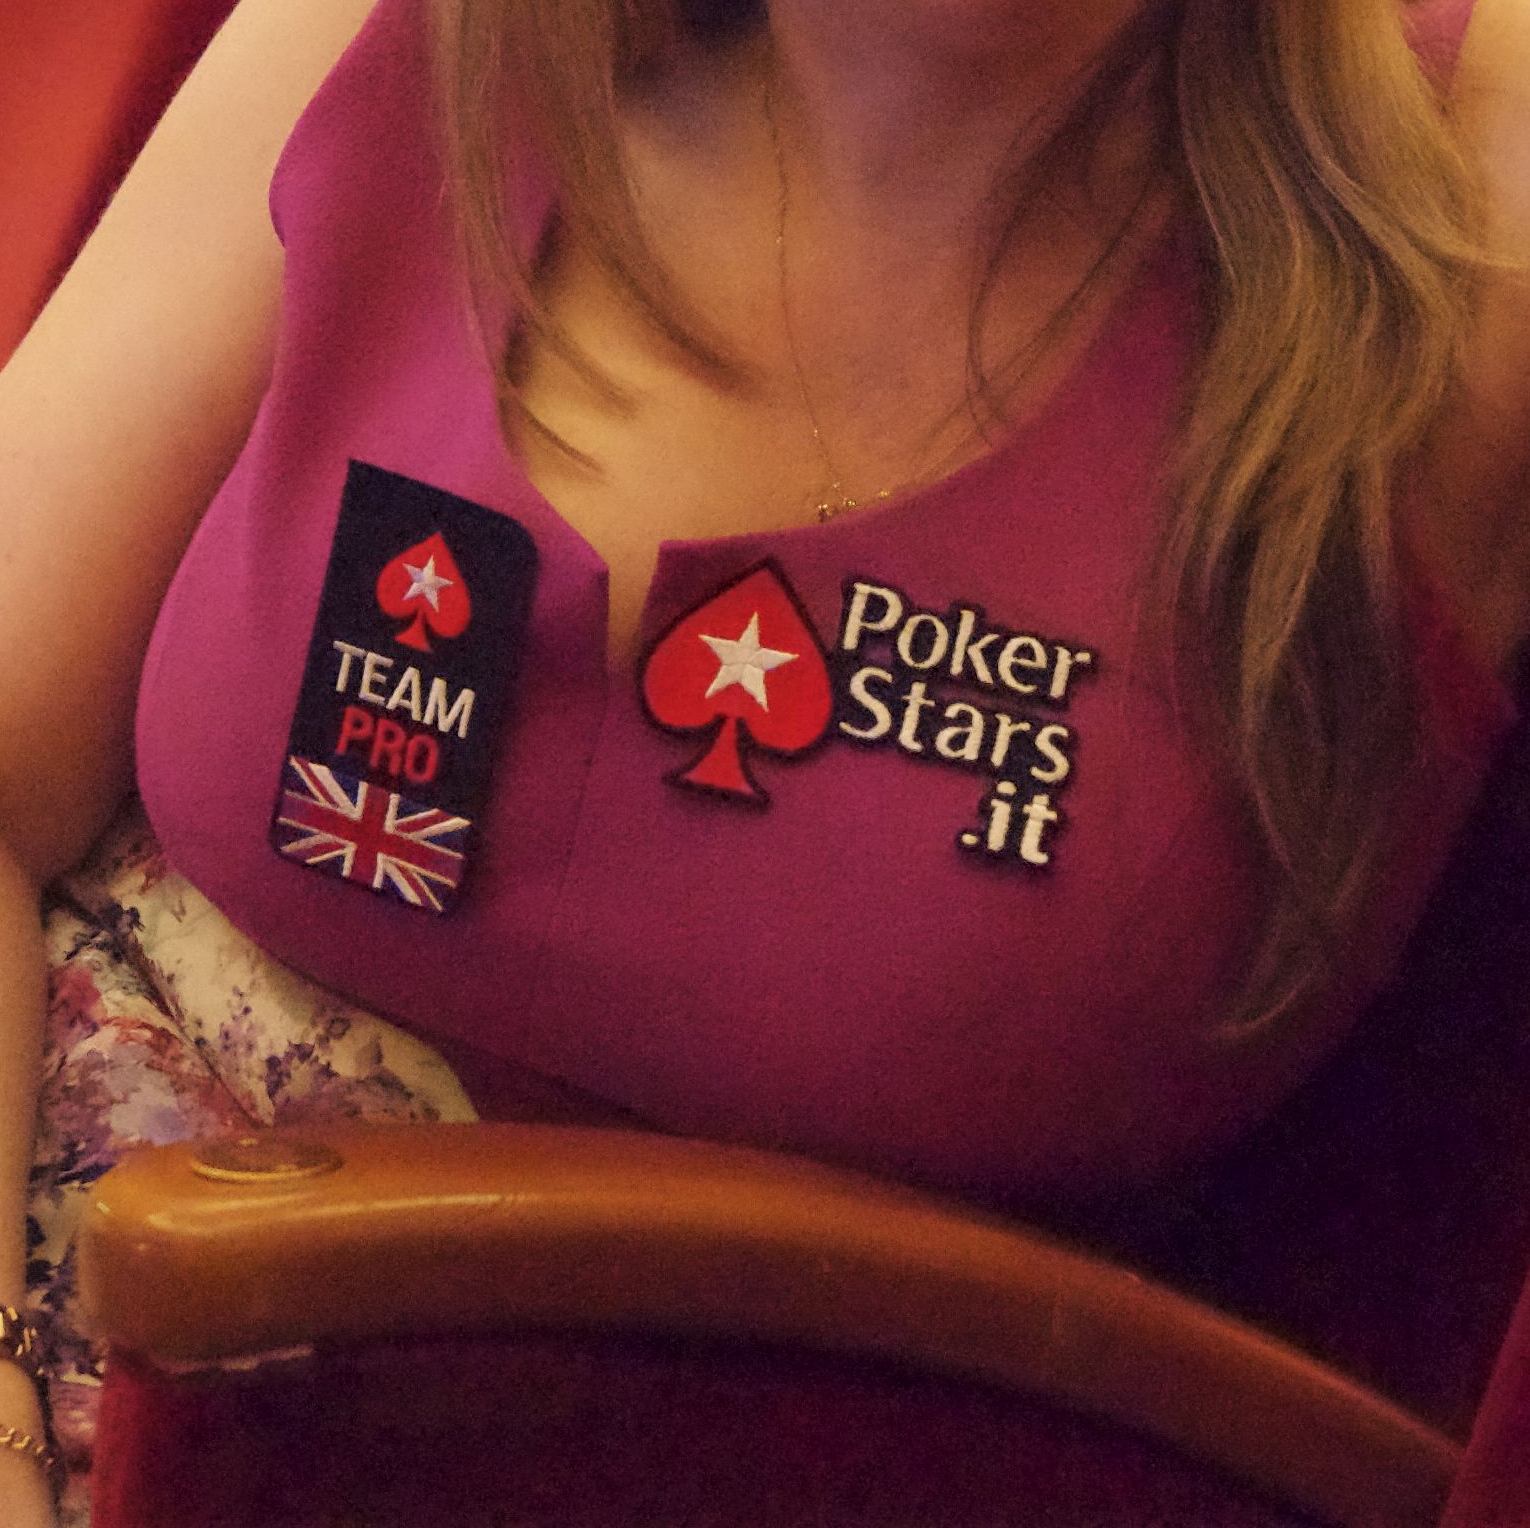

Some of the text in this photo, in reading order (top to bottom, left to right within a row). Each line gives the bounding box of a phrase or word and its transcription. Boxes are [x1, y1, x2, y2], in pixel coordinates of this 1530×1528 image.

[333, 640, 476, 739] TEAM
[843, 582, 1092, 699] Poker
[335, 706, 440, 783] PRO
[839, 667, 1070, 783] Stars
[961, 780, 1058, 864] .it
